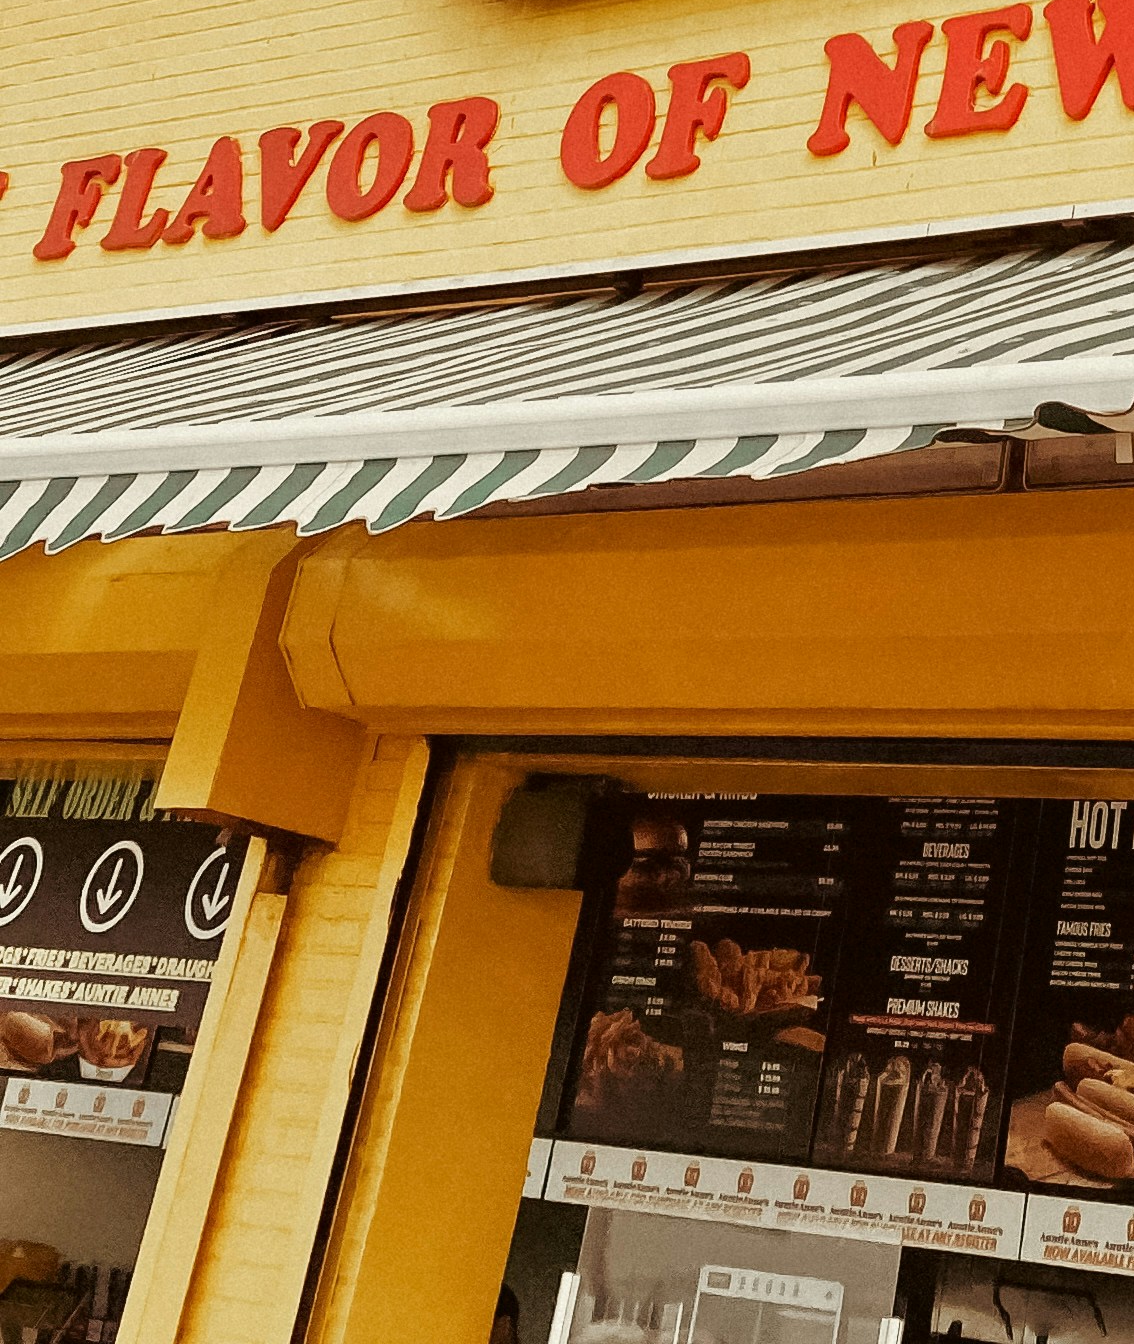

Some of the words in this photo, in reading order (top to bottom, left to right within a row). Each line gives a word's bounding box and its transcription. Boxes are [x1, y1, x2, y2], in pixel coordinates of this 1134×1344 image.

[33, 95, 500, 261] FLAVOR
[560, 52, 752, 190] OF
[1068, 800, 1128, 850] HOT
[1043, 1244, 1071, 1261] NOW
